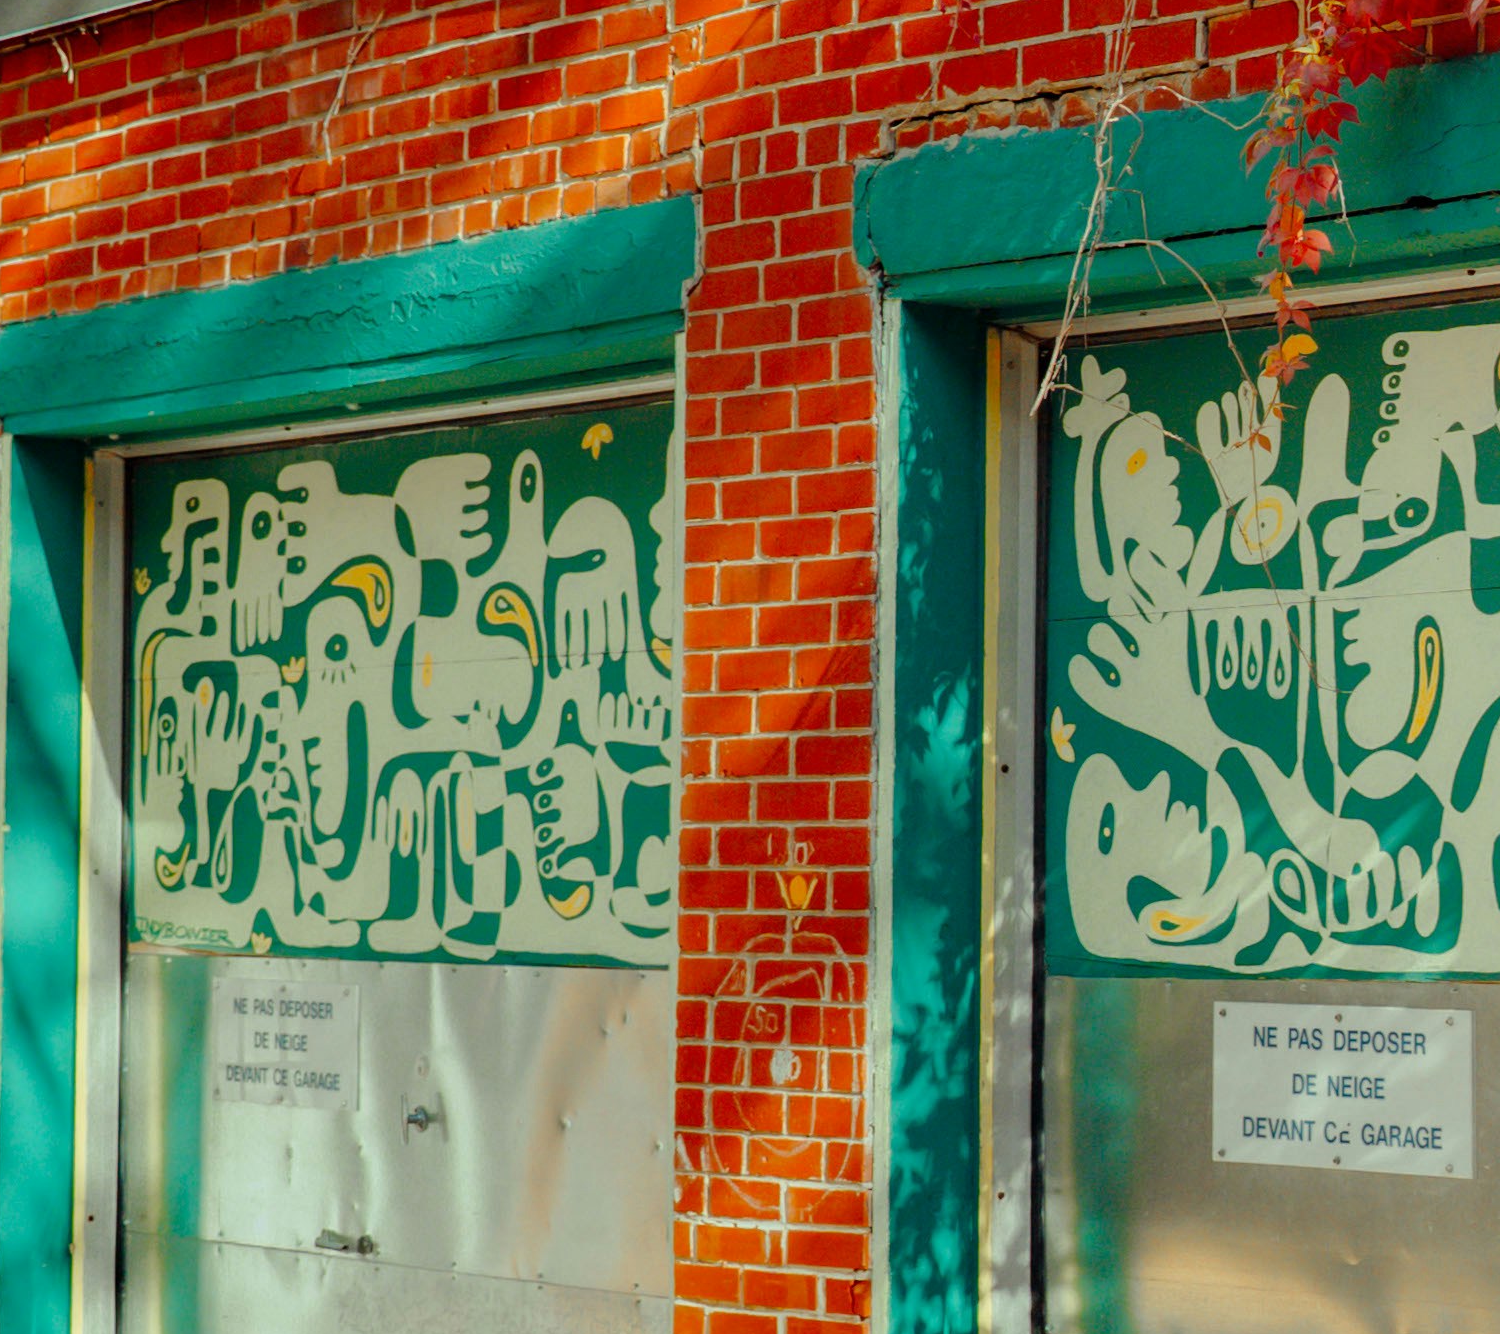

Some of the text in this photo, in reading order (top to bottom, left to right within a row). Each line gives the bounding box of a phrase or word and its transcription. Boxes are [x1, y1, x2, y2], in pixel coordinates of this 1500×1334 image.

[233, 997, 334, 1020] NE PAS DEPOSER
[254, 1031, 308, 1053] DE NEIGE
[1253, 1026, 1426, 1055] NE PAS DEPOSER
[225, 1064, 341, 1092] DEVANT CE GARAGE
[1292, 1073, 1386, 1100] DE NEIGE
[1242, 1116, 1315, 1142] DEVANT
[1361, 1123, 1443, 1150] GARAGE
